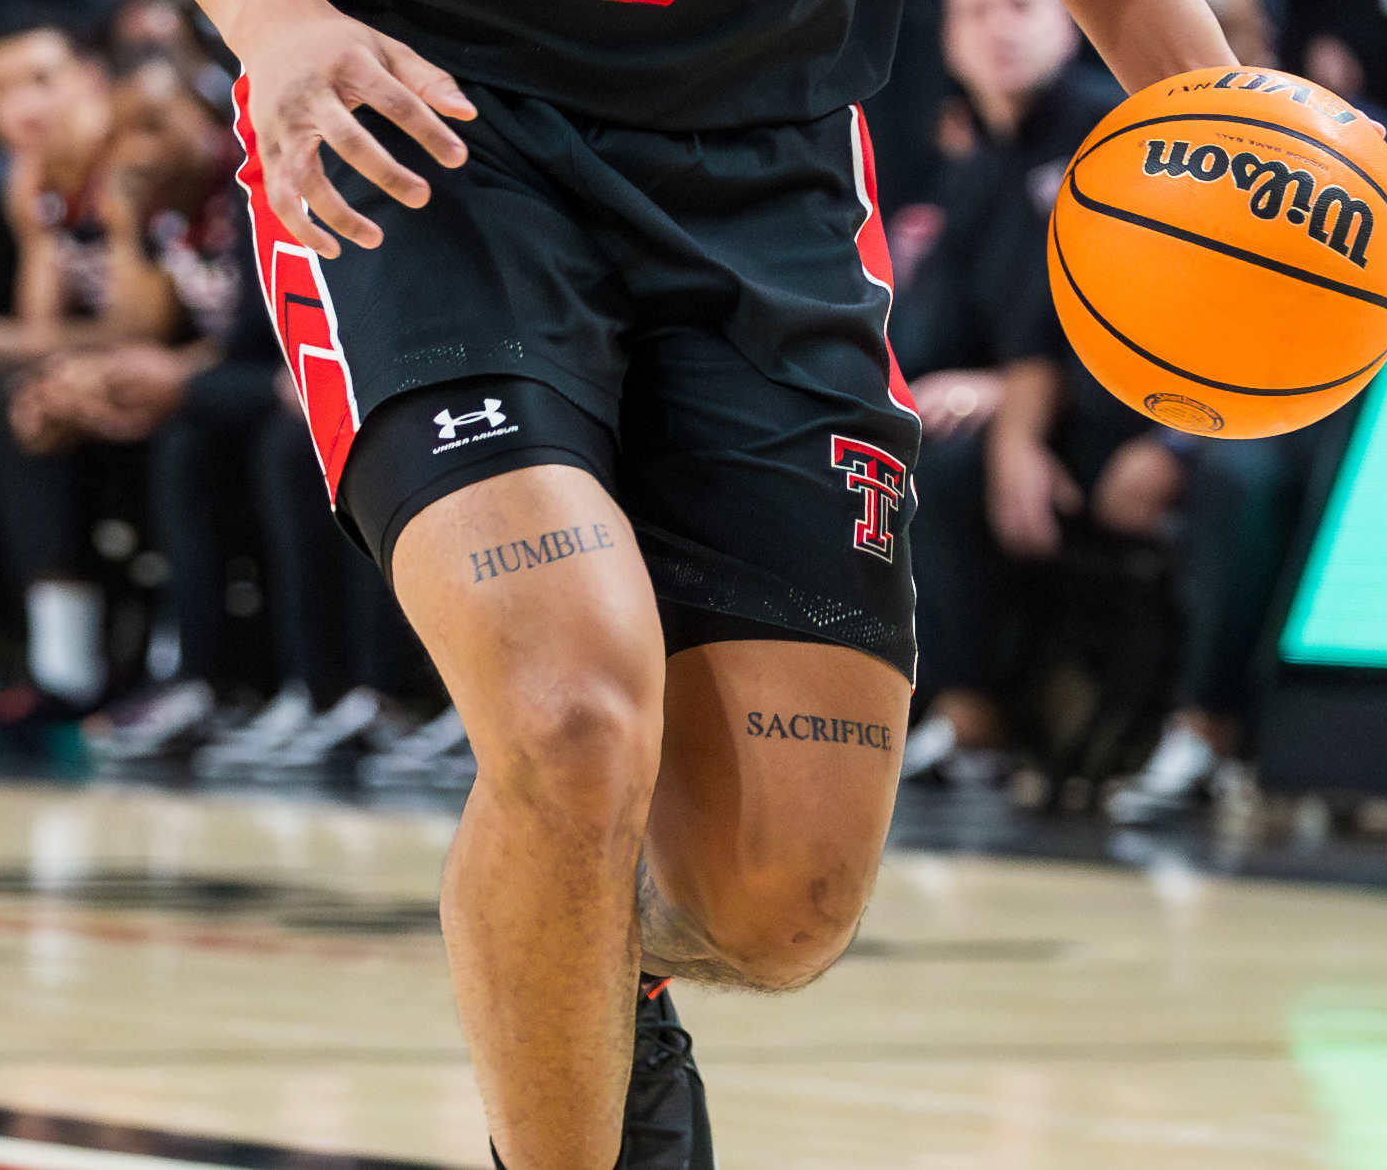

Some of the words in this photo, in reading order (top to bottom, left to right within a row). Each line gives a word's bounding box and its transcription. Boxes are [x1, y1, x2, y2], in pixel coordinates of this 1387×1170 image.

[1142, 139, 1374, 270] Wilson
[432, 437, 469, 455] UNDER
[471, 425, 519, 443] ARMOUR
[469, 523, 614, 584] HUMBLE
[747, 711, 893, 752] SACRIFICE
